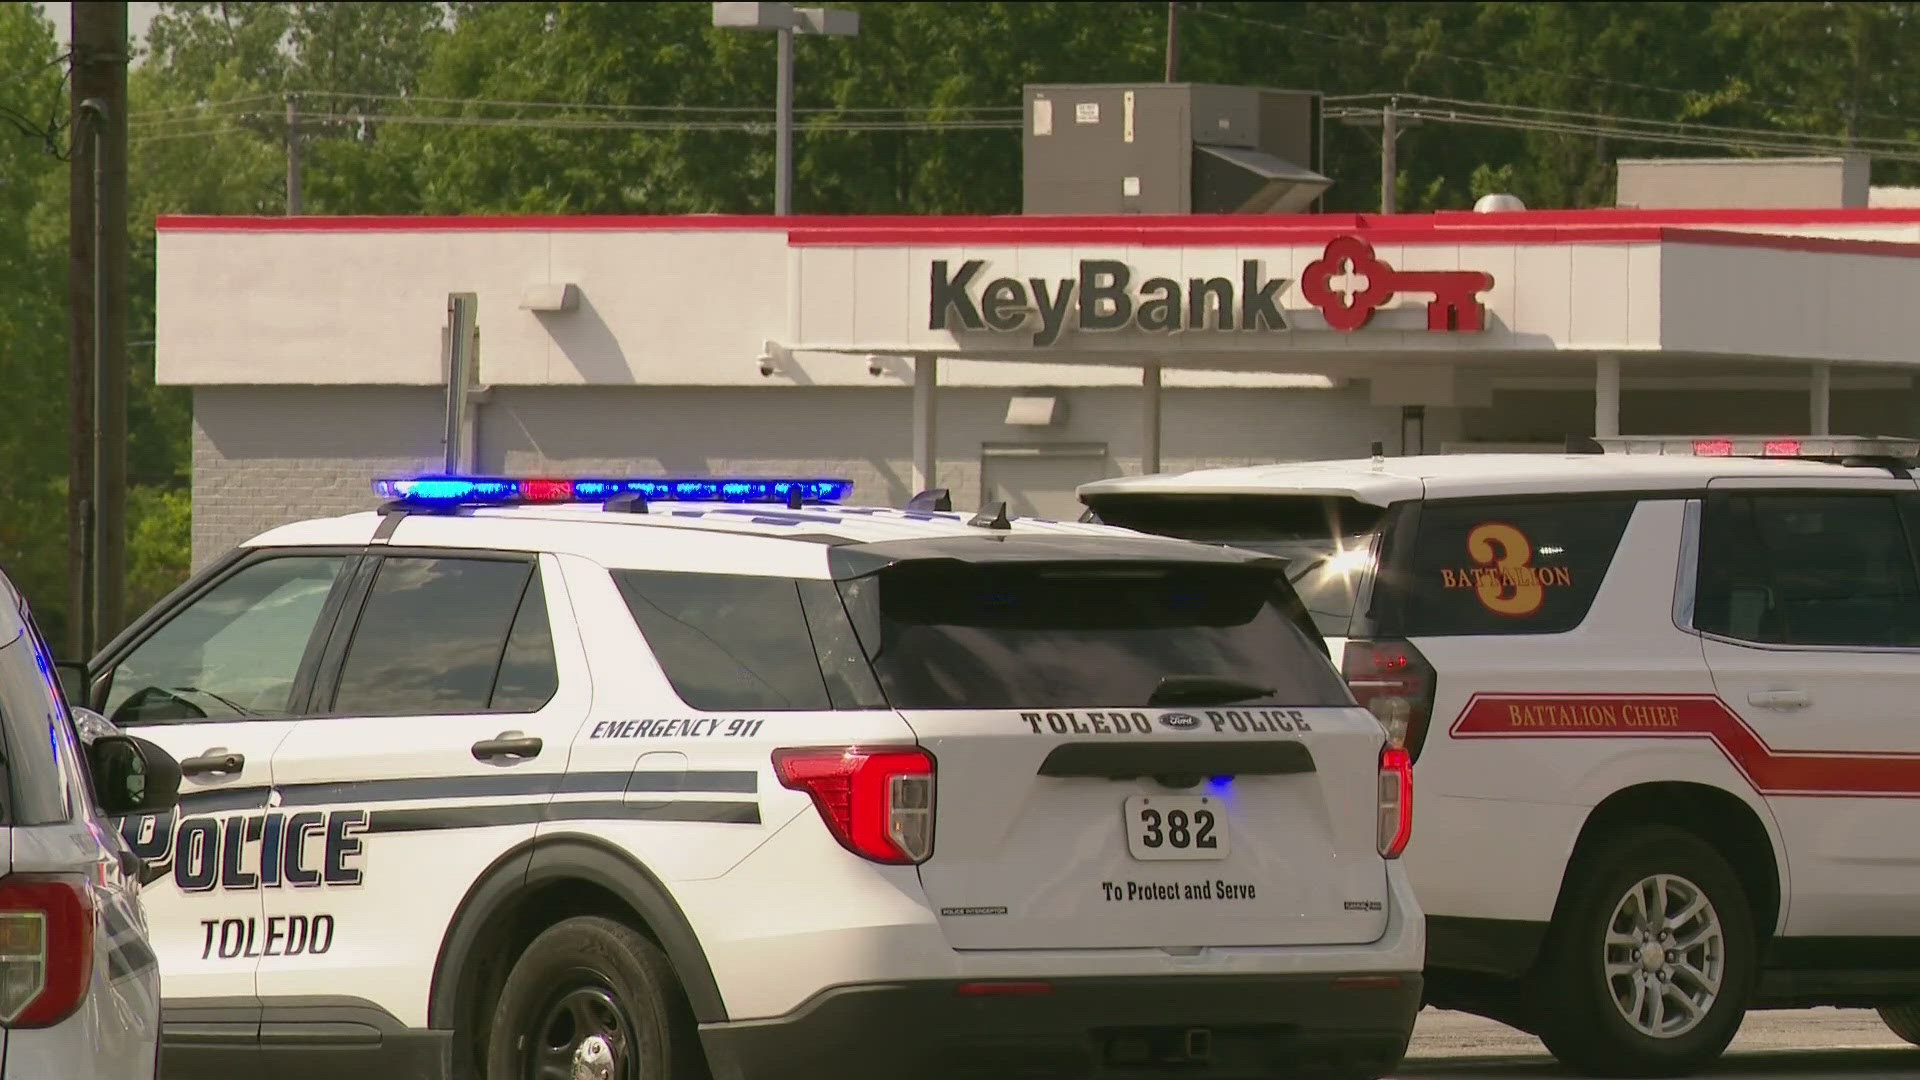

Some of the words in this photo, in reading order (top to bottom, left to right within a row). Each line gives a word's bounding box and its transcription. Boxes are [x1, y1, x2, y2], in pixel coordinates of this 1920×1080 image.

[930, 259, 1291, 346] KeyBank
[1441, 566, 1571, 588] BATTALION
[1467, 520, 1544, 616] 3
[1020, 712, 1152, 734] TOLEDO
[1205, 711, 1312, 732] POLICE
[1169, 714, 1193, 725] Ford
[1509, 704, 1617, 727] BATTALION
[1622, 704, 1680, 727] CHIEF
[590, 718, 724, 739] EMERGENCY
[724, 718, 765, 737] 911
[1141, 809, 1217, 849] 382
[118, 809, 369, 892] POLICE
[1102, 882, 1123, 901] To
[1127, 881, 1180, 901] Protect
[1184, 880, 1211, 900] and
[1216, 879, 1256, 900] Serve
[201, 914, 335, 960] TOLEDO
